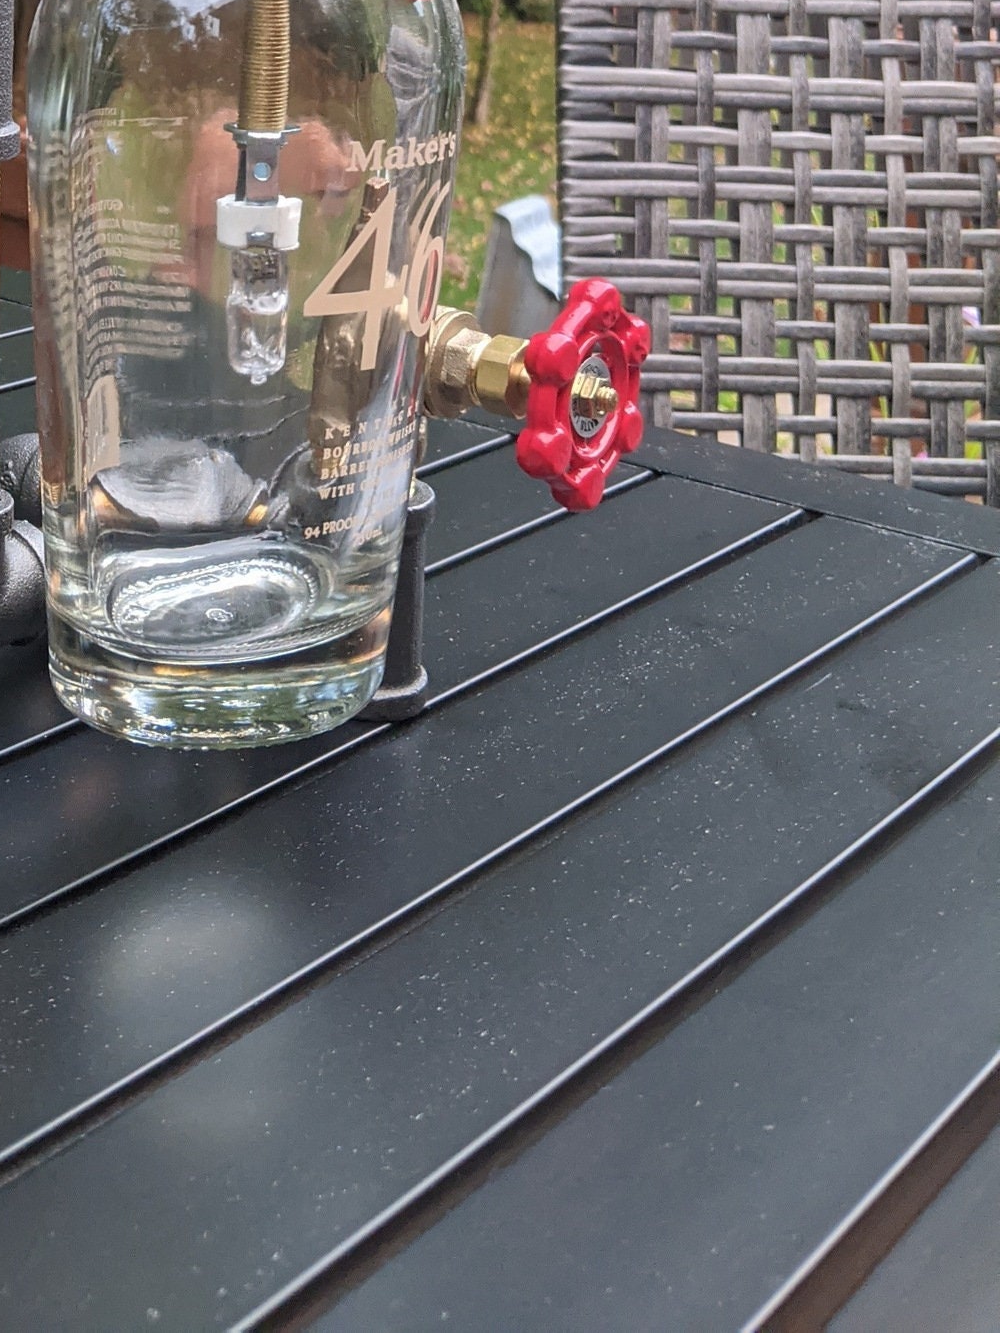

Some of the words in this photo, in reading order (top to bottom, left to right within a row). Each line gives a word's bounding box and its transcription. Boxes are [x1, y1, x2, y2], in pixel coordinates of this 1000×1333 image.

[345, 131, 456, 172] Maker's
[303, 181, 450, 370] 46
[318, 482, 355, 501] WITH
[304, 525, 320, 540] 94
